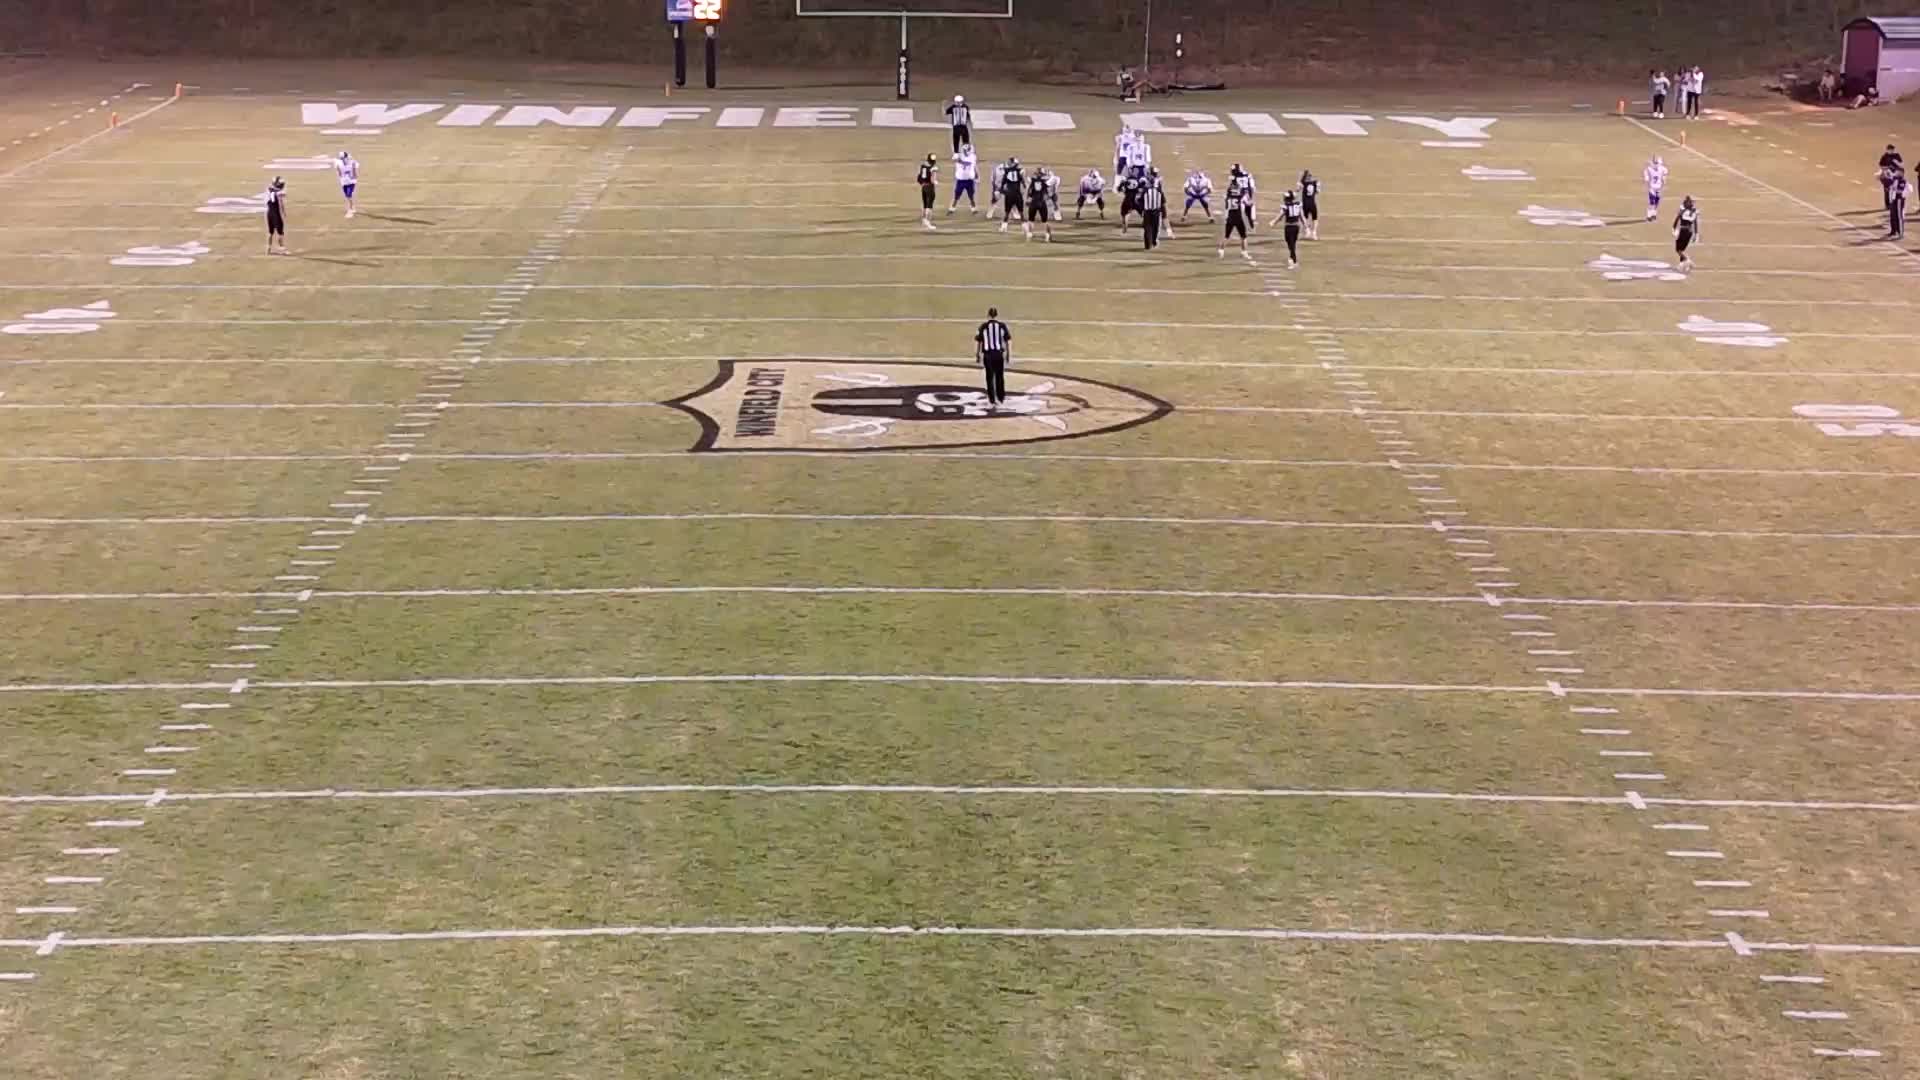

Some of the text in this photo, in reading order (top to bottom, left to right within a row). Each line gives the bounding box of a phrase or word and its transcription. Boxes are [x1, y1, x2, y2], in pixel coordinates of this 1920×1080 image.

[302, 103, 1498, 138] WINFIELD CITY
[734, 368, 786, 437] WINFIELD CITY
[1792, 404, 1920, 437] 50
